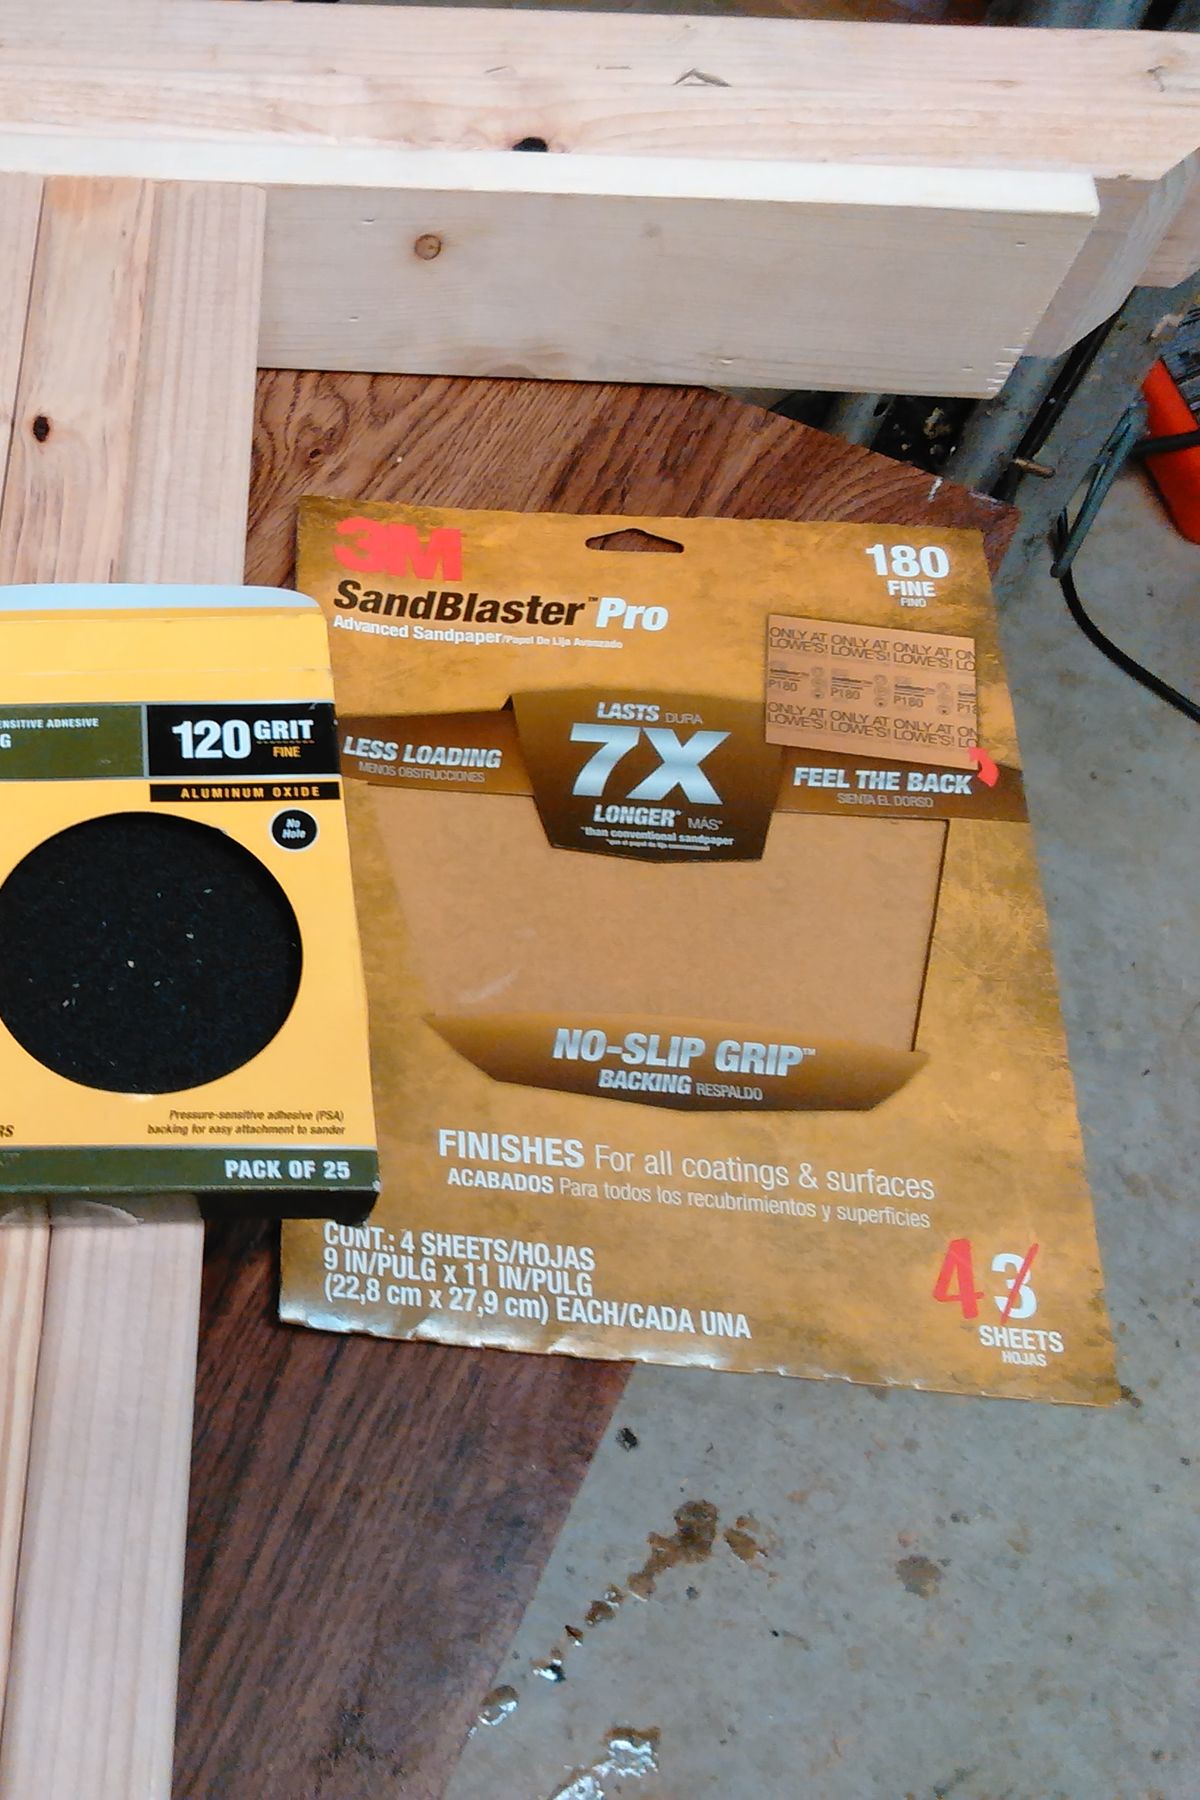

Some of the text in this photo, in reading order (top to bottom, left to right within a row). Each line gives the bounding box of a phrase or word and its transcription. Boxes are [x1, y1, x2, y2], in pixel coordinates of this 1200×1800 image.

[333, 517, 463, 581] 3M
[865, 543, 949, 578] 180
[887, 580, 936, 598] FINE
[595, 596, 669, 631] Pro
[900, 598, 927, 608] FINO
[333, 615, 409, 638] Advanced
[769, 627, 828, 642] ONLY AT
[831, 634, 890, 650] ONLY AT
[893, 642, 952, 657] ONLY AT
[596, 702, 703, 725] LASTS DURA
[768, 701, 827, 718] ONLY AT
[830, 710, 890, 727] ONLY AT
[893, 718, 954, 734] ONLY AT
[172, 719, 314, 759] 120 GRIT
[272, 746, 301, 758] FINE
[342, 736, 503, 769] LESS LOADING
[358, 761, 396, 777] MENOS
[569, 723, 731, 805] 7X
[793, 767, 972, 795] FEEL THE BACK
[180, 786, 320, 799] ALUMINUM OXIDE
[282, 828, 306, 839] Hole
[285, 818, 301, 829] No
[678, 833, 735, 846] sandpaper
[552, 1028, 705, 1068] NO-SLIP
[598, 1069, 763, 1101] BACKING RESPALDO
[169, 1110, 344, 1122] Pressure-sensitive adhesive (PSA)
[147, 1125, 346, 1136] backing for easy attachment to sander
[224, 1159, 351, 1180] PACK OF 25
[438, 1129, 935, 1200] FINISHES For all coatings & surfaces
[448, 1167, 930, 1228] ACABADOS Para todos los recubrimientos y superficies
[400, 1231, 415, 1254] 4
[421, 1232, 596, 1272] SHEETS/HOJAS
[323, 1247, 593, 1297] 9 IN/PULG x 11 IN/PULG
[933, 1238, 1037, 1319] 4 3
[324, 1273, 753, 1340] (22,8 cm x 27,9 cm) EACH/CADA UNA
[978, 1325, 1064, 1353] SHEETS
[1001, 1350, 1048, 1367] HOJAS
